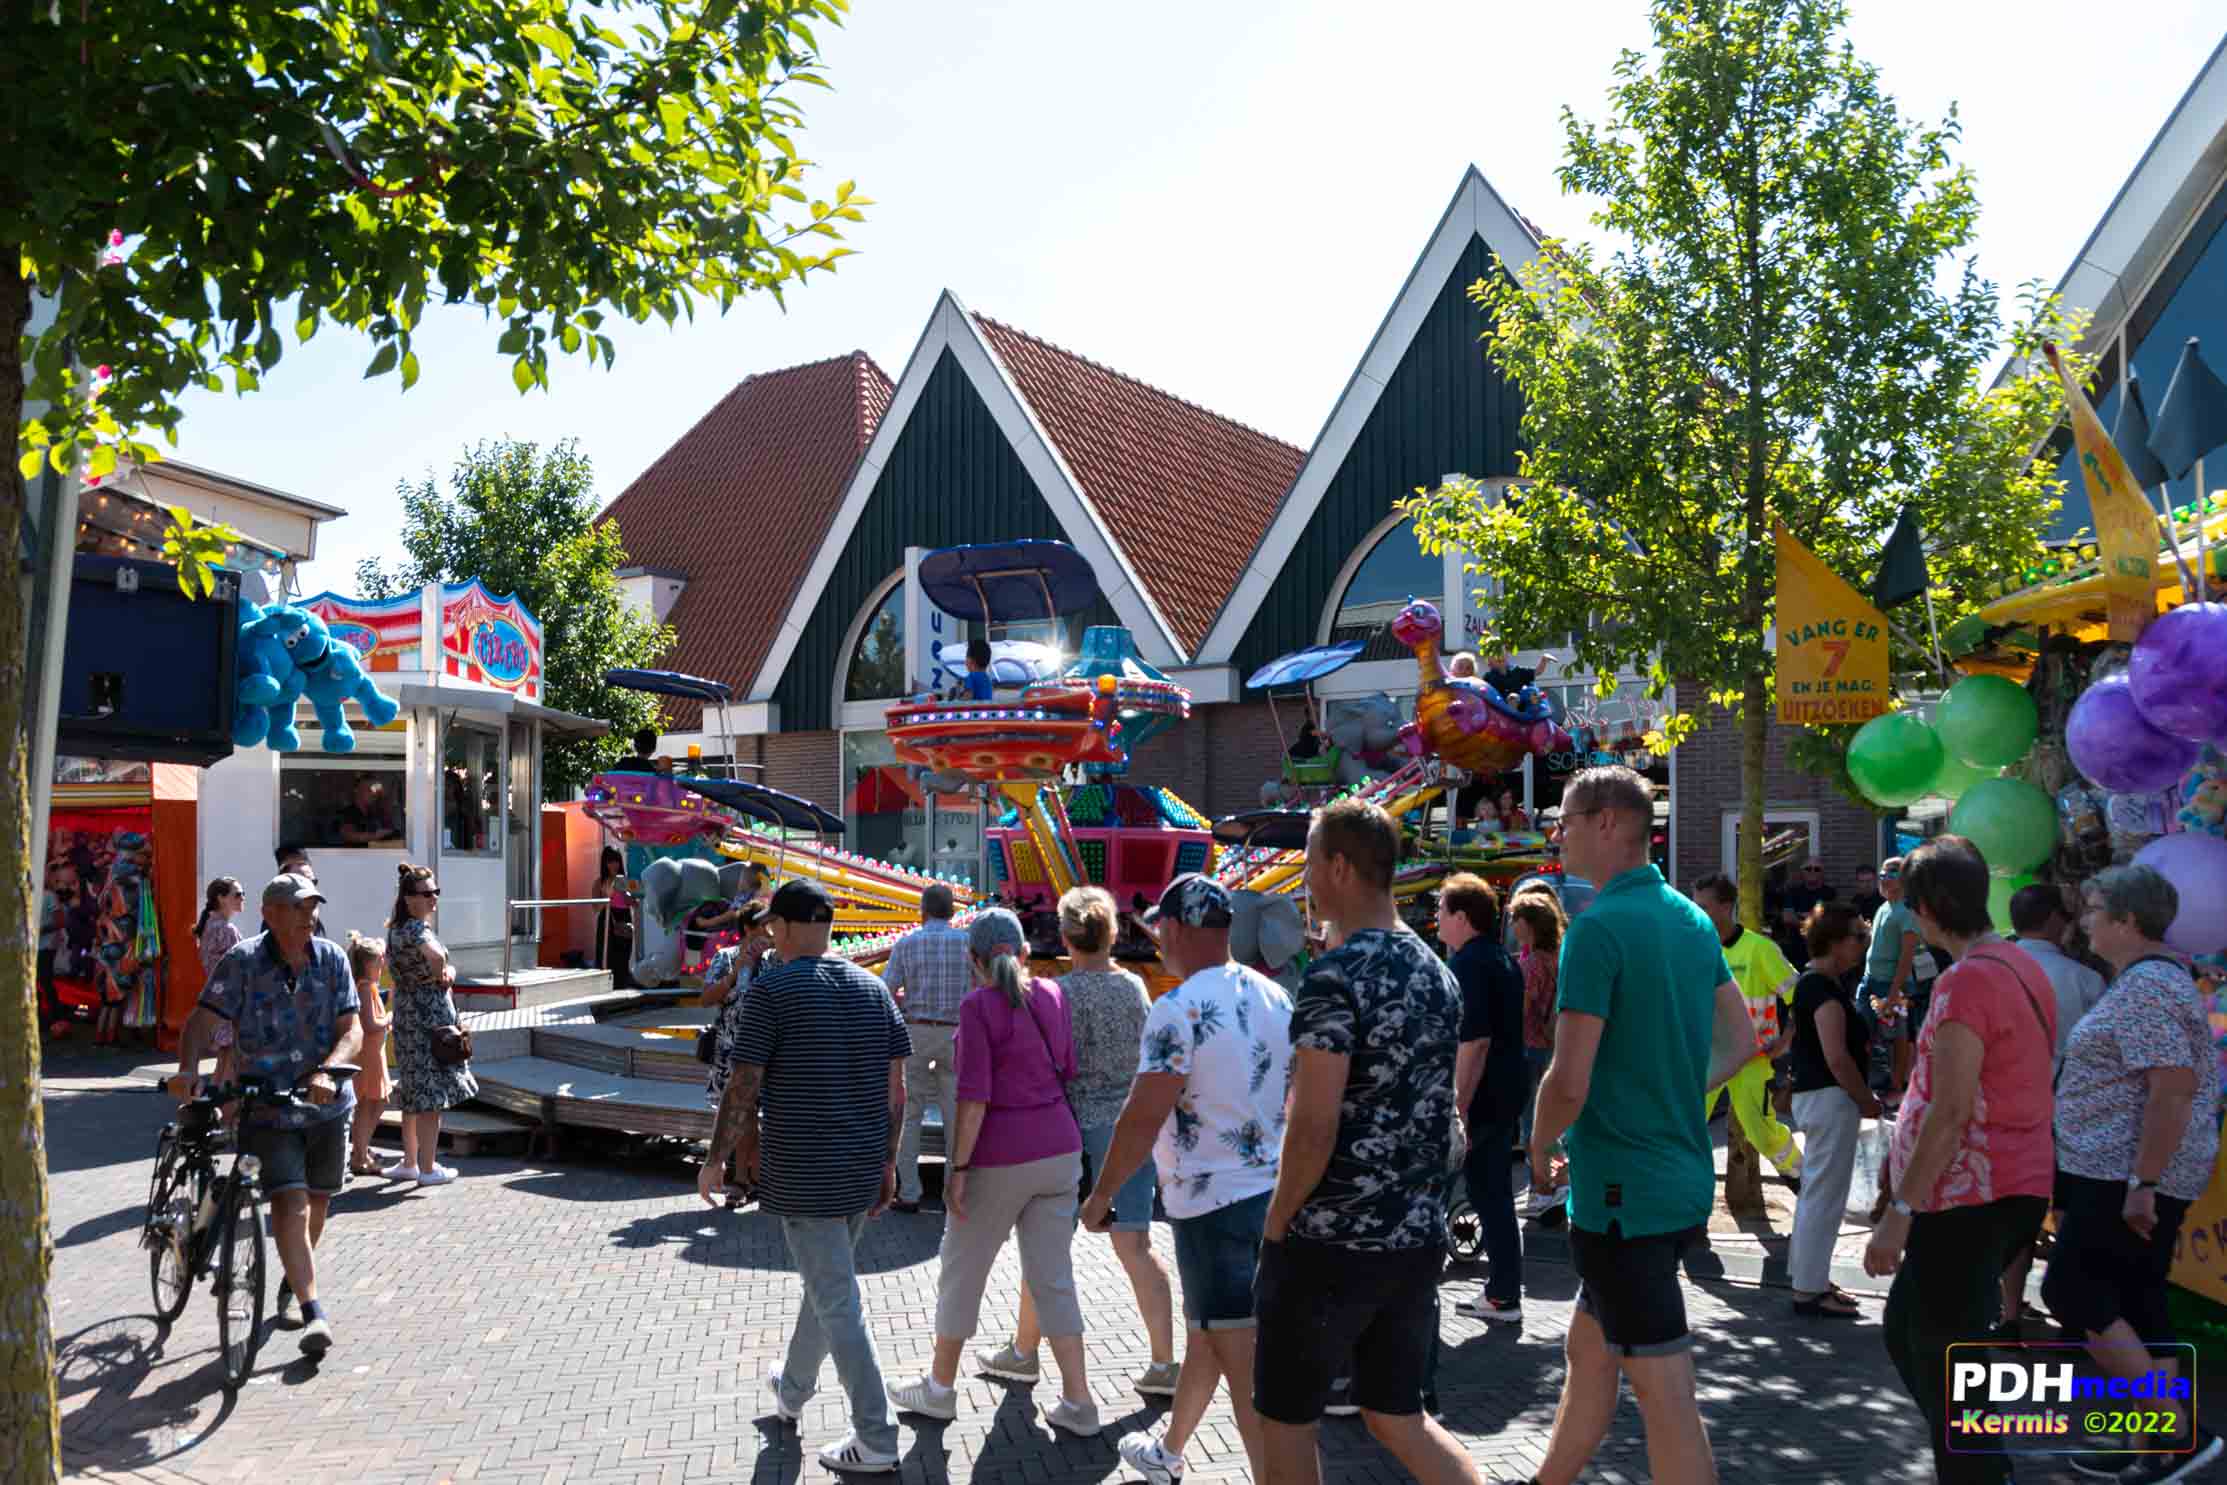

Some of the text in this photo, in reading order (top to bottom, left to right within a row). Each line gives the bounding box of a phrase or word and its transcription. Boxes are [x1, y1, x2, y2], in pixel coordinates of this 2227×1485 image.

[1784, 618, 1879, 647] VANG ER
[477, 631, 528, 674] CIRCUS
[1823, 639, 1851, 677] 7
[1792, 681, 1811, 694] EN
[1816, 680, 1831, 693] JE
[1783, 698, 1885, 721] UITZOEKEN
